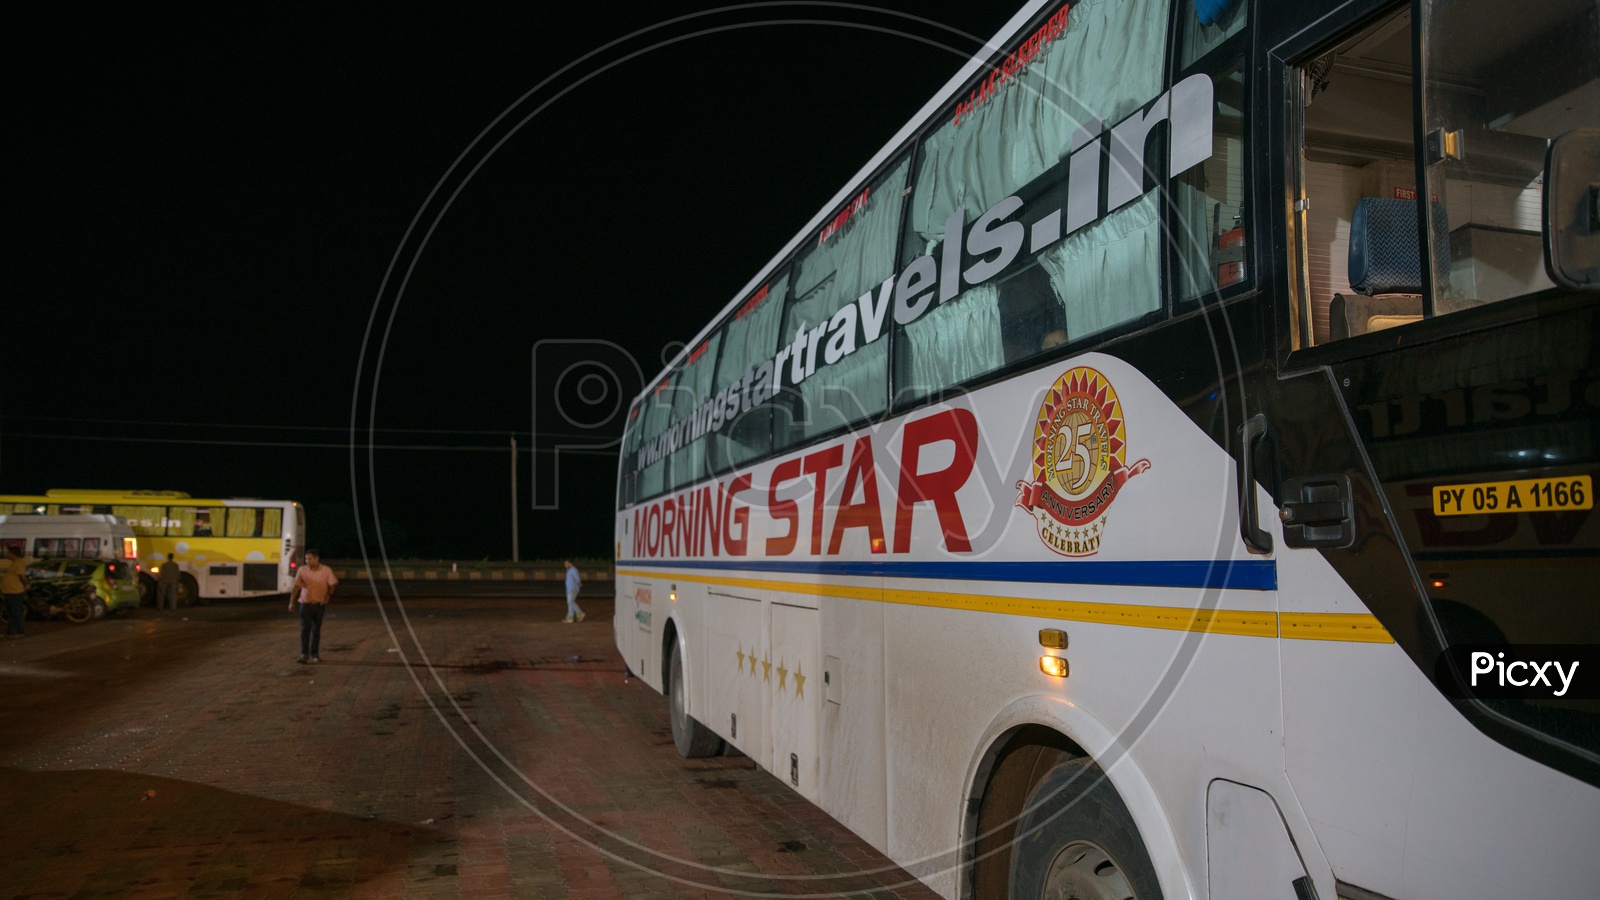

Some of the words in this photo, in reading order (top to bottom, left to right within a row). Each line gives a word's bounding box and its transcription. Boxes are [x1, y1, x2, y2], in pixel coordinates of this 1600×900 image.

[1000, 3, 1070, 85] SLEEPER
[1396, 187, 1415, 200] FIRST
[1046, 406, 1067, 482] MORNING
[1066, 396, 1091, 412] STAR
[1089, 403, 1110, 472] TRAVELS
[1055, 421, 1093, 490] 25
[632, 472, 752, 558] MORNING
[765, 407, 979, 557] STAR
[1041, 476, 1115, 520] ANNIVERSARY
[1439, 488, 1465, 513] PY
[1472, 486, 1498, 511] 05
[1506, 484, 1522, 509] A
[1530, 480, 1585, 508] 1166
